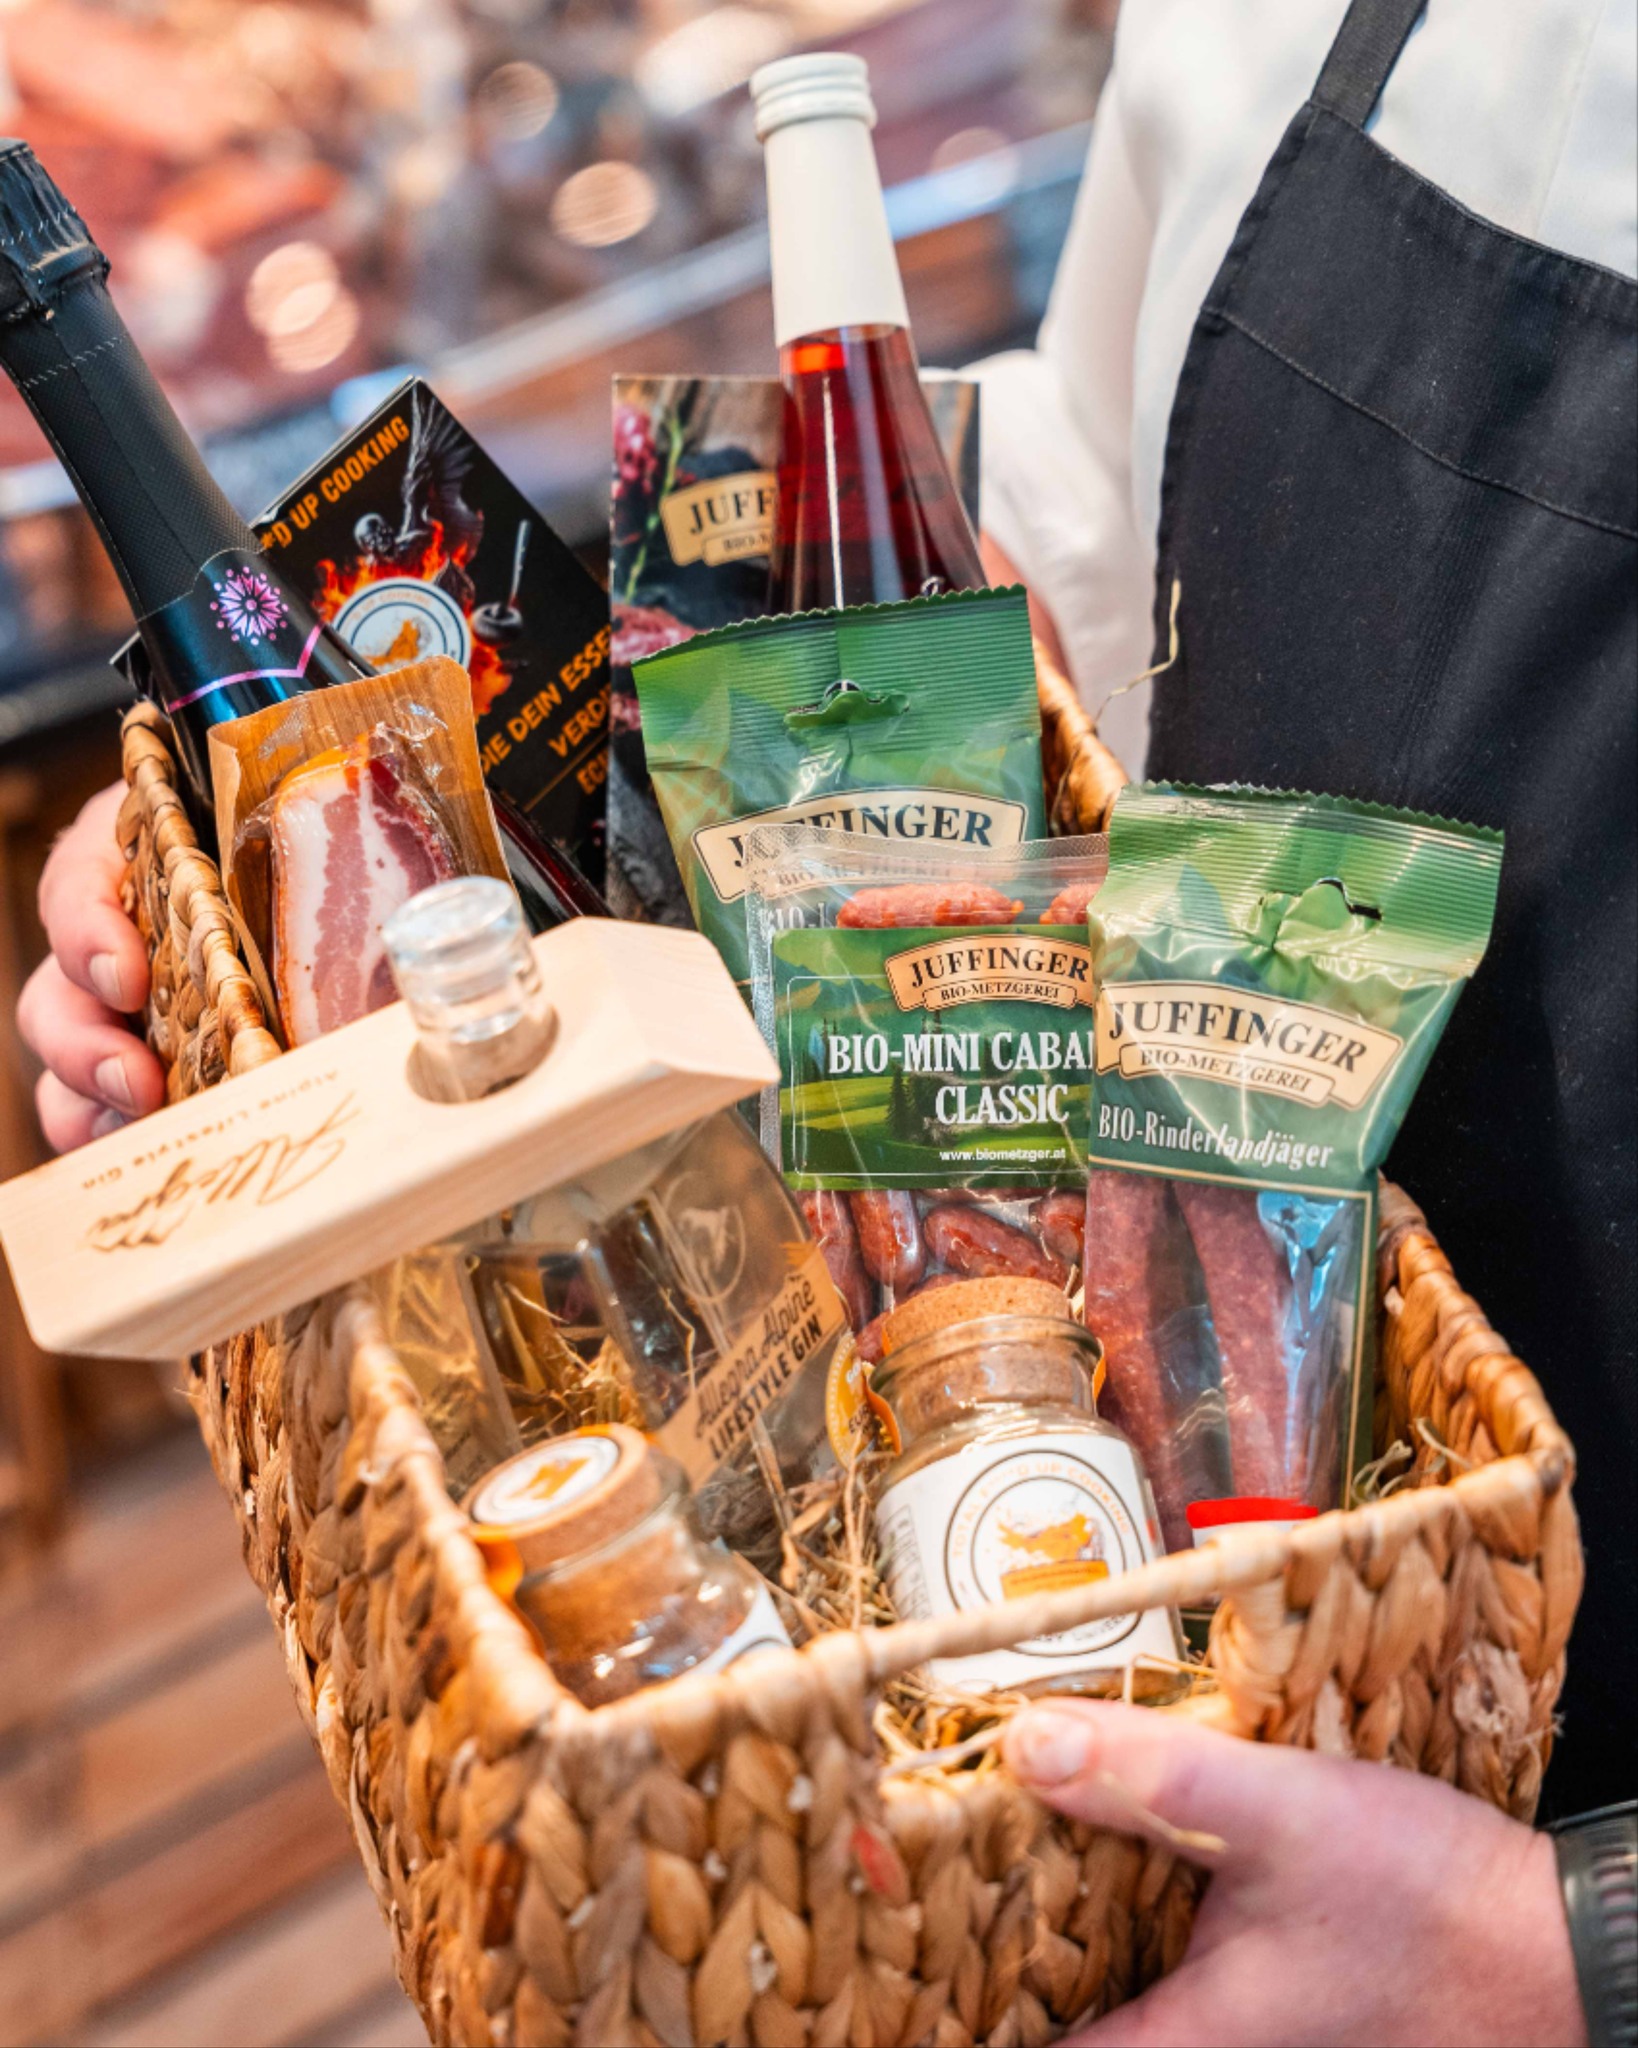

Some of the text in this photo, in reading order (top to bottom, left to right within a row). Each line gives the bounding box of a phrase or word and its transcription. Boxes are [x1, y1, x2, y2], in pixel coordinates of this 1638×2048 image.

[289, 492, 319, 529] UP
[320, 415, 410, 503] COOKING
[506, 682, 562, 742] DEIN
[909, 947, 1089, 988] JUFFINGER
[940, 981, 1060, 1001] BIO-METZGEREI
[828, 1033, 982, 1074] BIO-MINI
[1108, 1000, 1367, 1074] JUFFINGER
[1141, 1048, 1312, 1092] BIO-METZGEREI
[935, 1084, 1070, 1124] CLASSIC
[81, 1071, 338, 1190] Alpine Lifestyle Gin
[940, 1148, 1066, 1162] www.biometzger.at
[1098, 1103, 1334, 1171] BIO-Rinderlandjäger
[709, 1351, 793, 1459] LIFESTYLE
[793, 1316, 824, 1363] GIN
